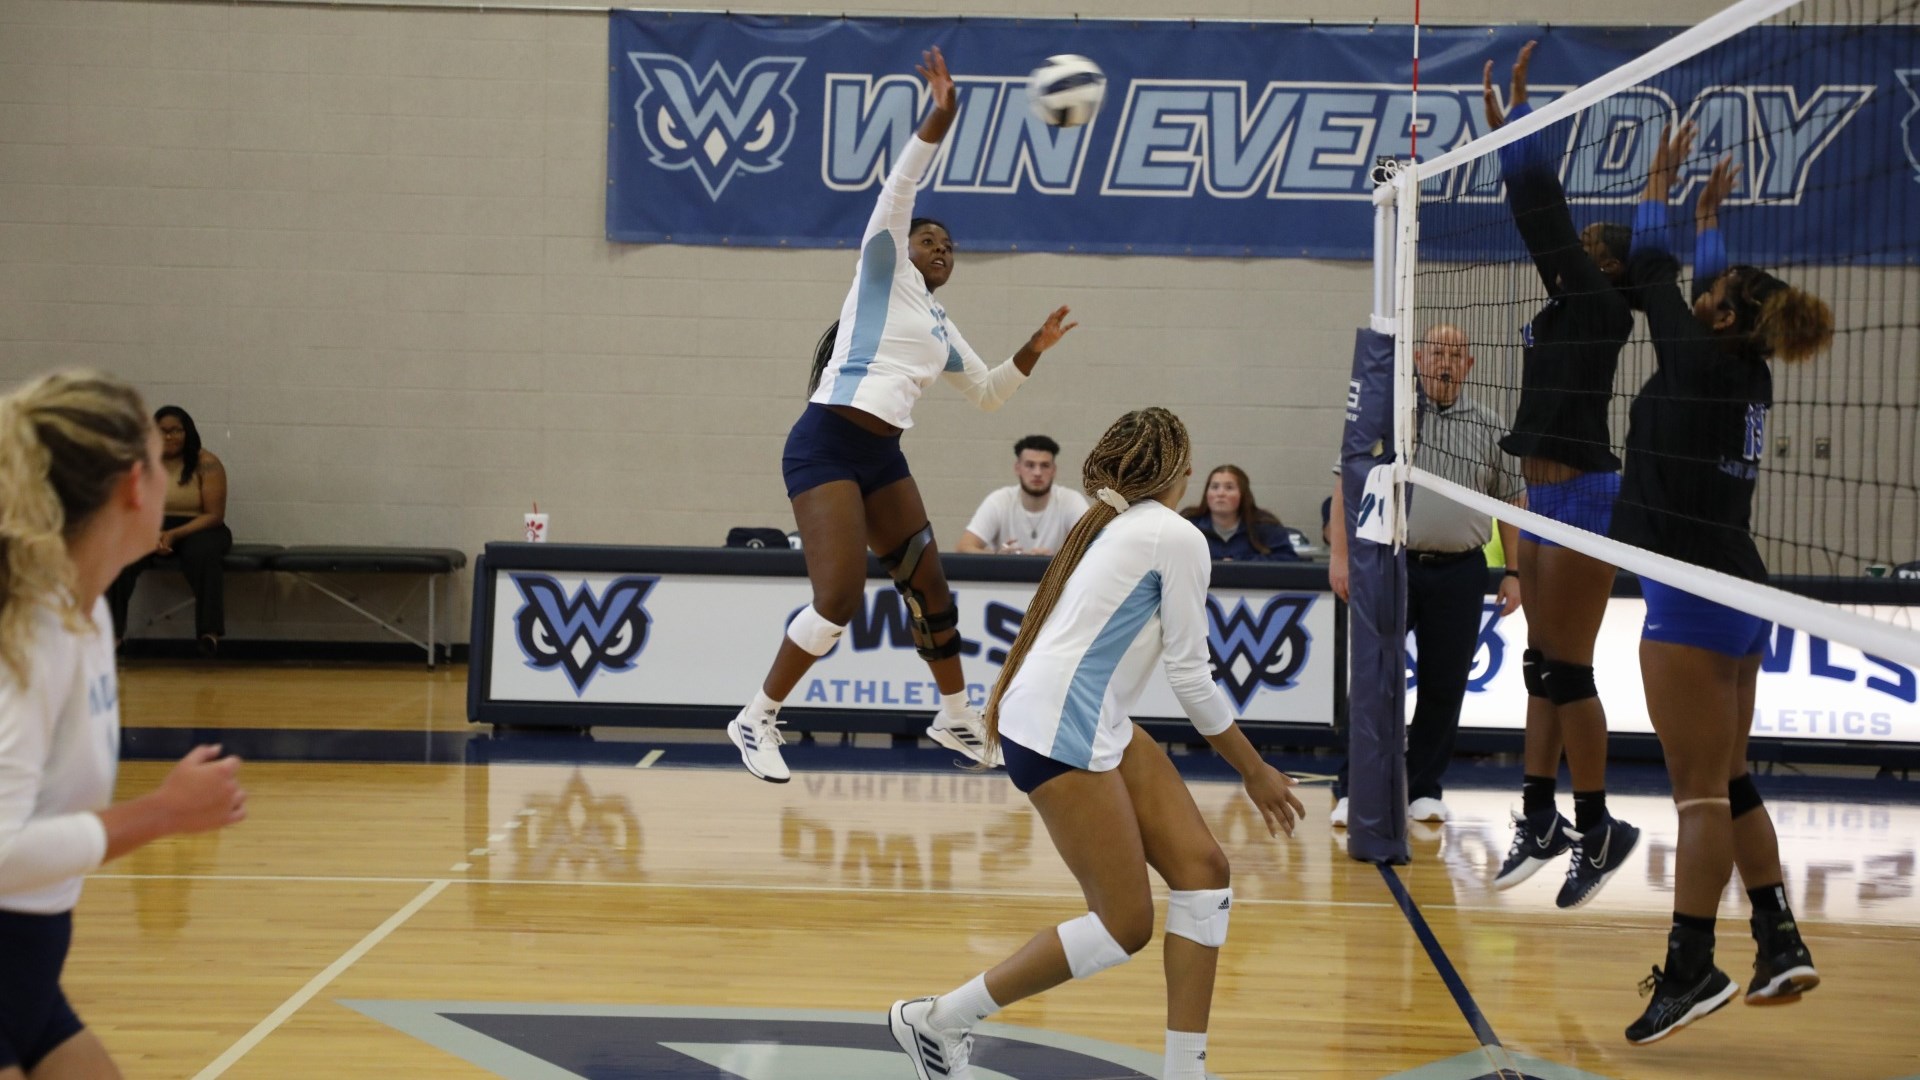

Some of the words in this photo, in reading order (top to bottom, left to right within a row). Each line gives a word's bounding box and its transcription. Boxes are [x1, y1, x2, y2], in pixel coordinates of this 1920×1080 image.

[821, 73, 1106, 195] WIN
[1100, 79, 1578, 204] EVERY
[1556, 84, 1877, 205] DAY
[805, 679, 996, 706] ATHLETC
[1754, 709, 1892, 735] LETICS
